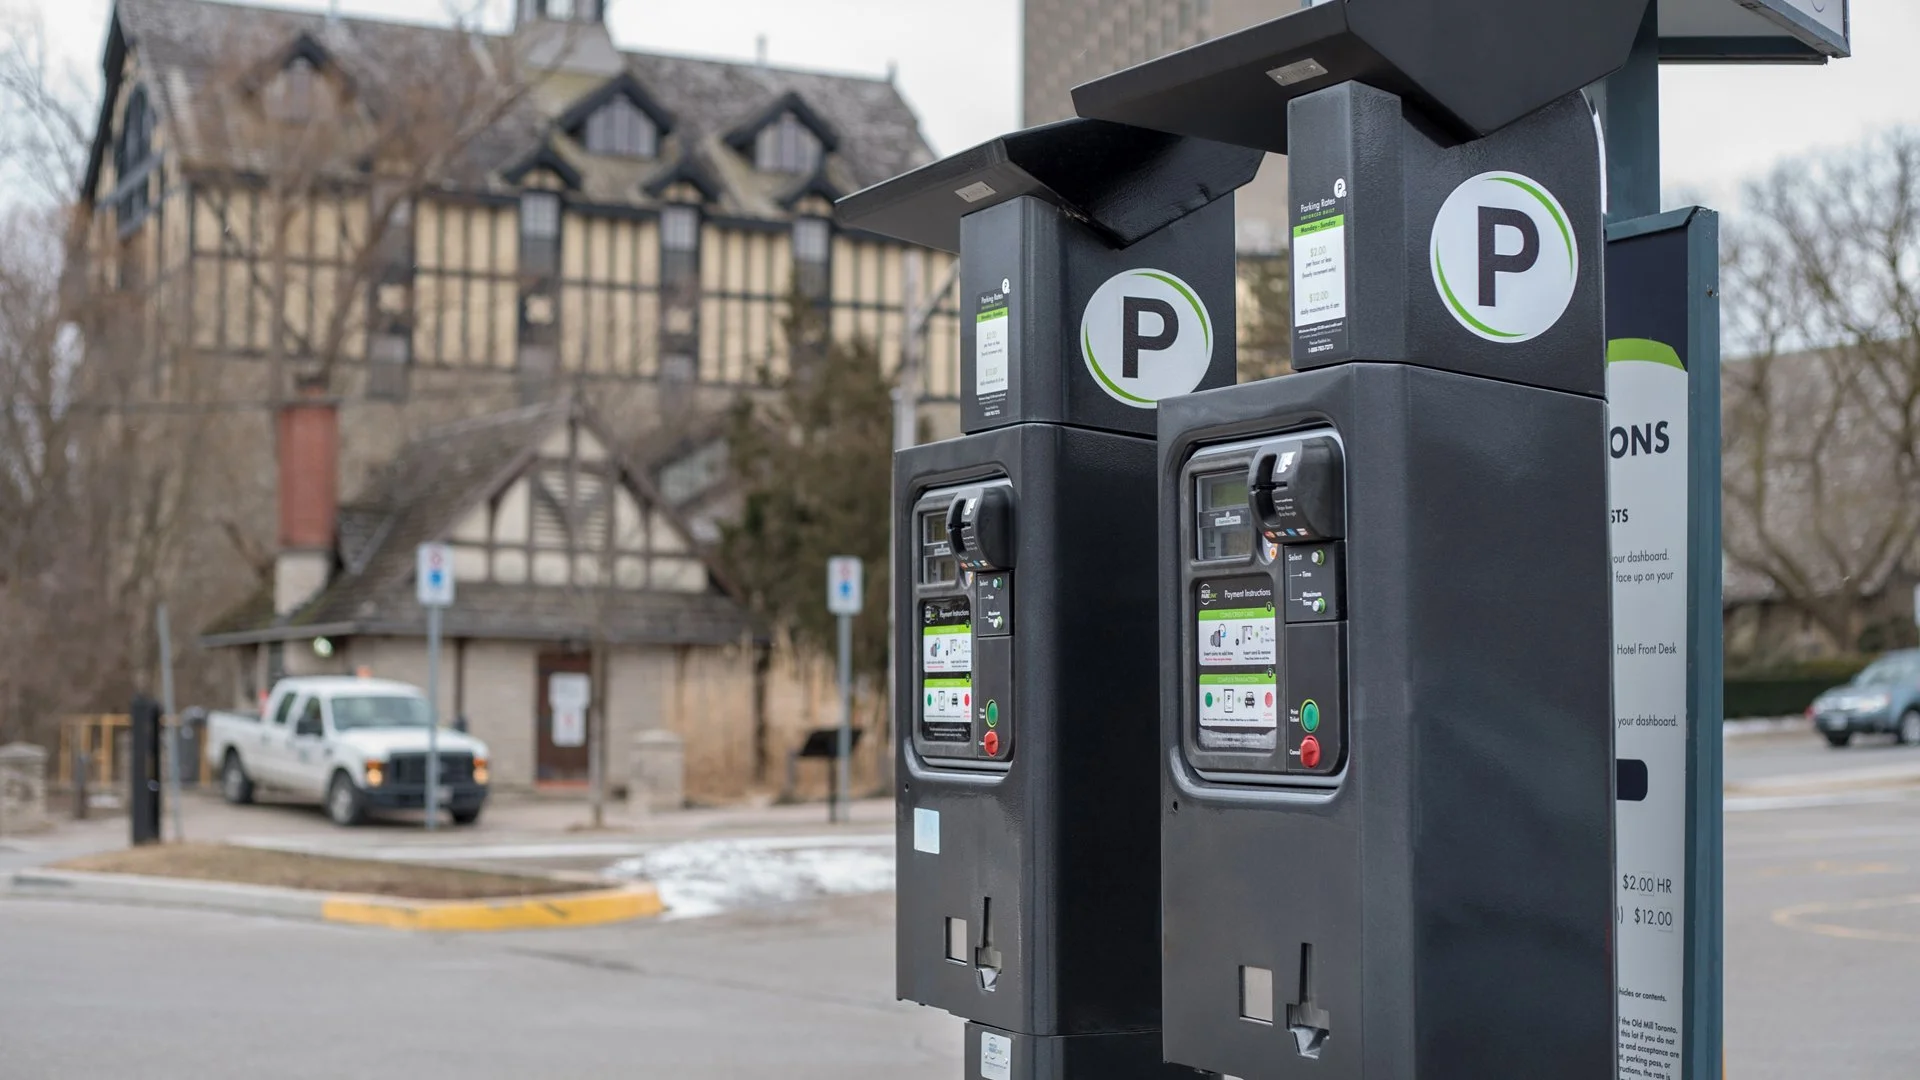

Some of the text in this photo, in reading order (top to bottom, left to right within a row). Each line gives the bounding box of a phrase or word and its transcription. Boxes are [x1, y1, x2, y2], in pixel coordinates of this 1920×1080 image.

[1301, 198, 1336, 213] Parking Rates
[1301, 225, 1318, 233] Monday
[1320, 220, 1336, 228] Sunday
[1477, 205, 1540, 308] P
[1122, 296, 1179, 379] P
[1288, 553, 1302, 561] Select
[1628, 548, 1670, 562] dashboard.
[1616, 570, 1632, 582] face
[1634, 574, 1642, 584] up
[1656, 571, 1674, 584] your
[1224, 588, 1271, 600] Payment Instructions
[1617, 642, 1676, 655] Hotel Front Desk
[1618, 714, 1678, 728] your dashboard.
[1622, 873, 1672, 894] $2.00 HR
[1634, 907, 1672, 926] $12.00
[1642, 993, 1668, 1002] contents.
[1622, 1016, 1630, 1026] the
[1632, 1018, 1642, 1028] Old
[1643, 1021, 1654, 1030] Mill
[1654, 1022, 1678, 1034] Toronto.
[1621, 1028, 1630, 1038] this
[1644, 1035, 1656, 1043] you
[1656, 1036, 1664, 1044] do
[1626, 1042, 1636, 1050] and
[1638, 1046, 1668, 1056] acceptance
[1626, 1055, 1647, 1066] parking
[1648, 1059, 1664, 1069] pass,
[1643, 1068, 1652, 1078] the
[1653, 1072, 1664, 1080] rate
